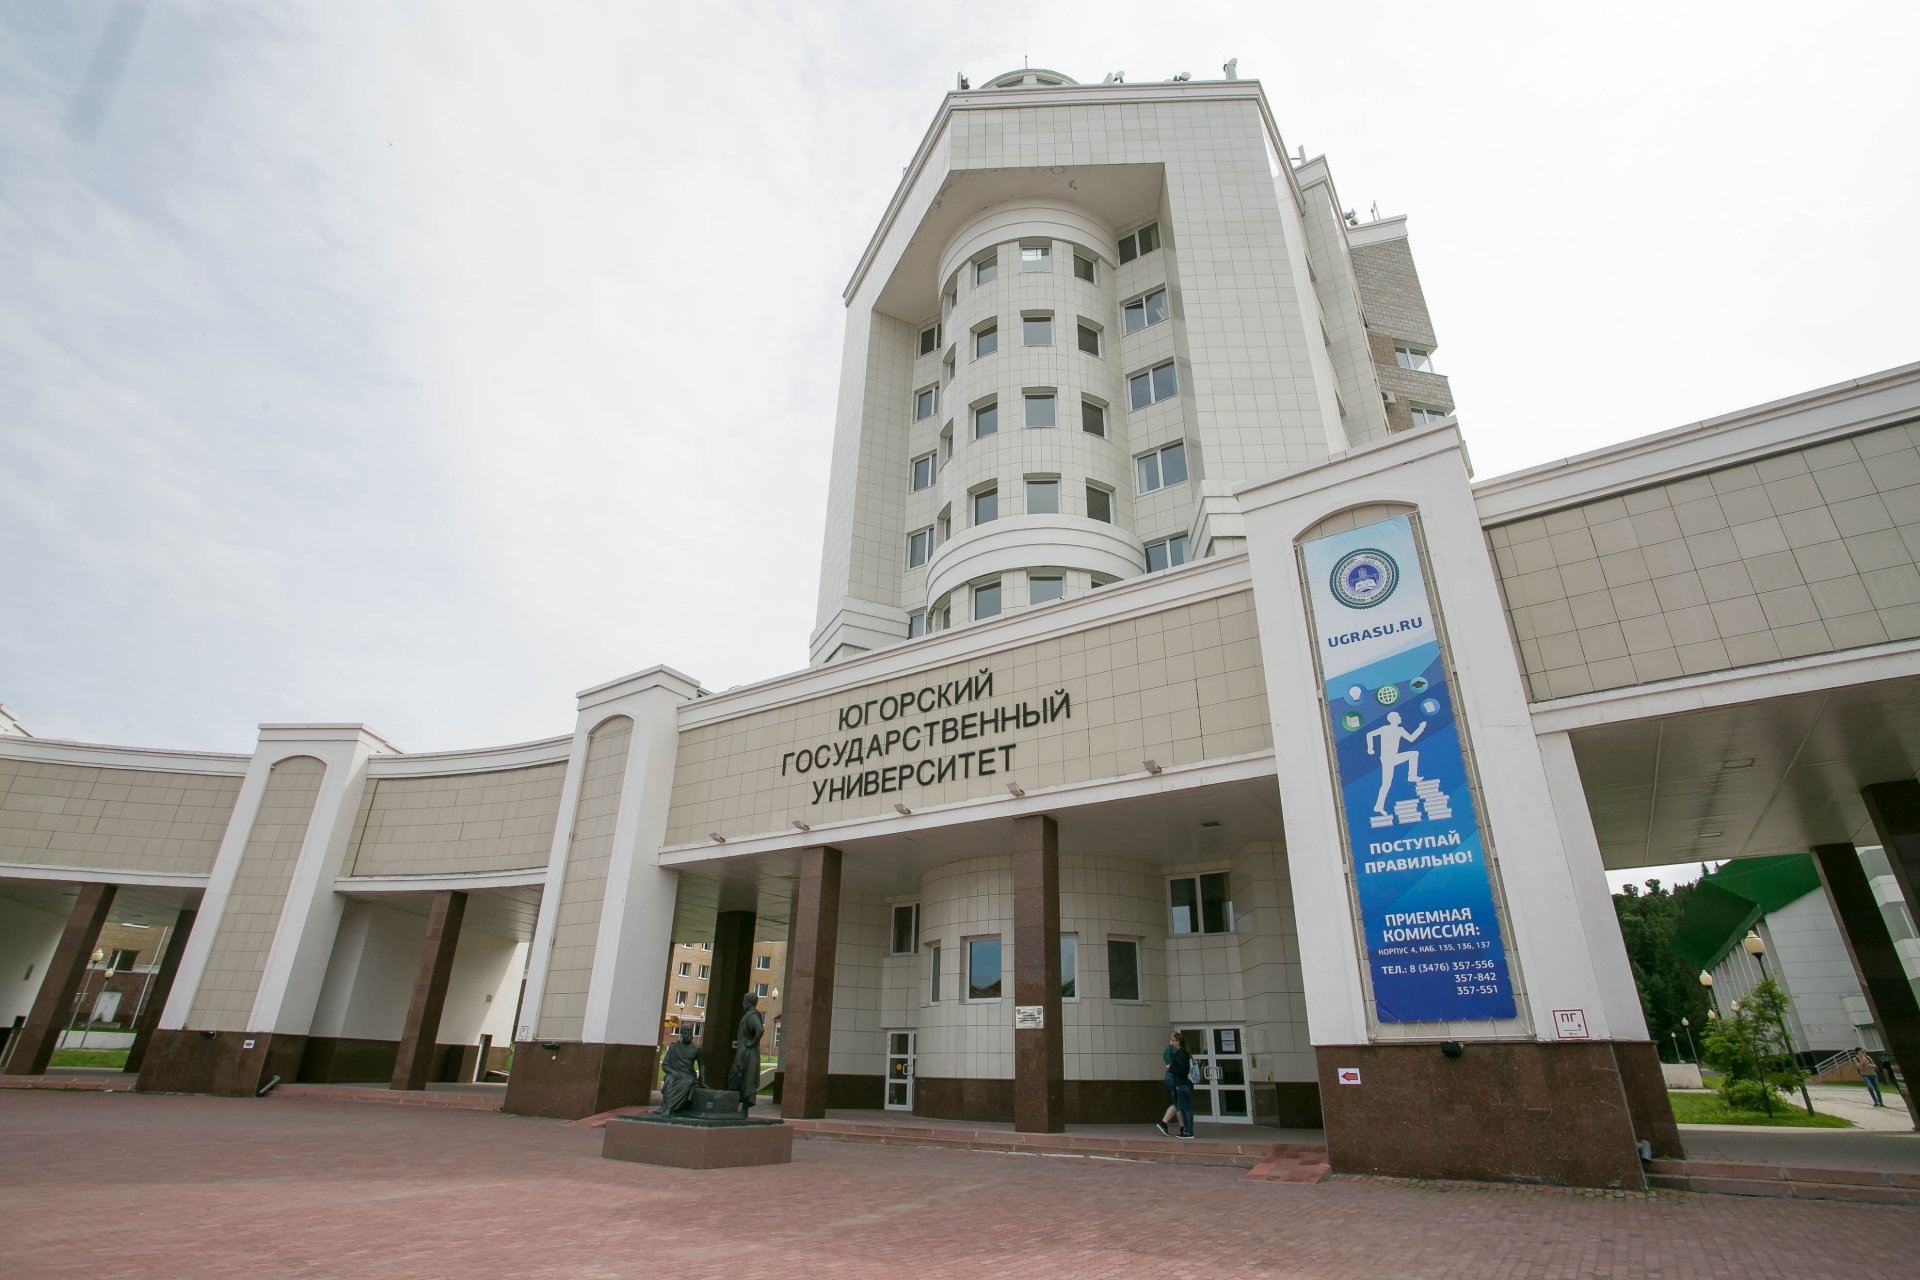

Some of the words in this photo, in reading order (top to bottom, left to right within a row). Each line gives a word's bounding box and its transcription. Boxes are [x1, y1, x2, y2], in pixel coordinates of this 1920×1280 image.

[1327, 617, 1423, 648] UGRASU.RU
[838, 667, 993, 731] ЮГОРСКИЙ
[781, 688, 1071, 776] ГОСУДАРСТВЕННЫЙ
[811, 743, 1017, 805] УНИВЕРСИТЕТ
[1369, 830, 1461, 855] ПОСТУПАЙ
[1364, 851, 1473, 874] ПРАВИЛЬНО!
[1385, 907, 1472, 927] ПРИЕМНАЯ
[1383, 922, 1481, 943] КОМИССИЯ:
[1378, 946, 1409, 956] КОРПУС
[1419, 945, 1437, 953] КАБ.
[1438, 943, 1456, 952] 135,
[1457, 942, 1475, 950] 136,
[1476, 941, 1490, 949] 137
[1381, 964, 1408, 975] ТЕЛ.:
[1409, 965, 1416, 973] 8
[1418, 962, 1450, 974] (3476)
[1452, 960, 1495, 971] 357-556
[1454, 972, 1497, 983] 357-842
[1456, 985, 1498, 996] 357-551
[1560, 1013, 1577, 1023] ПГ
